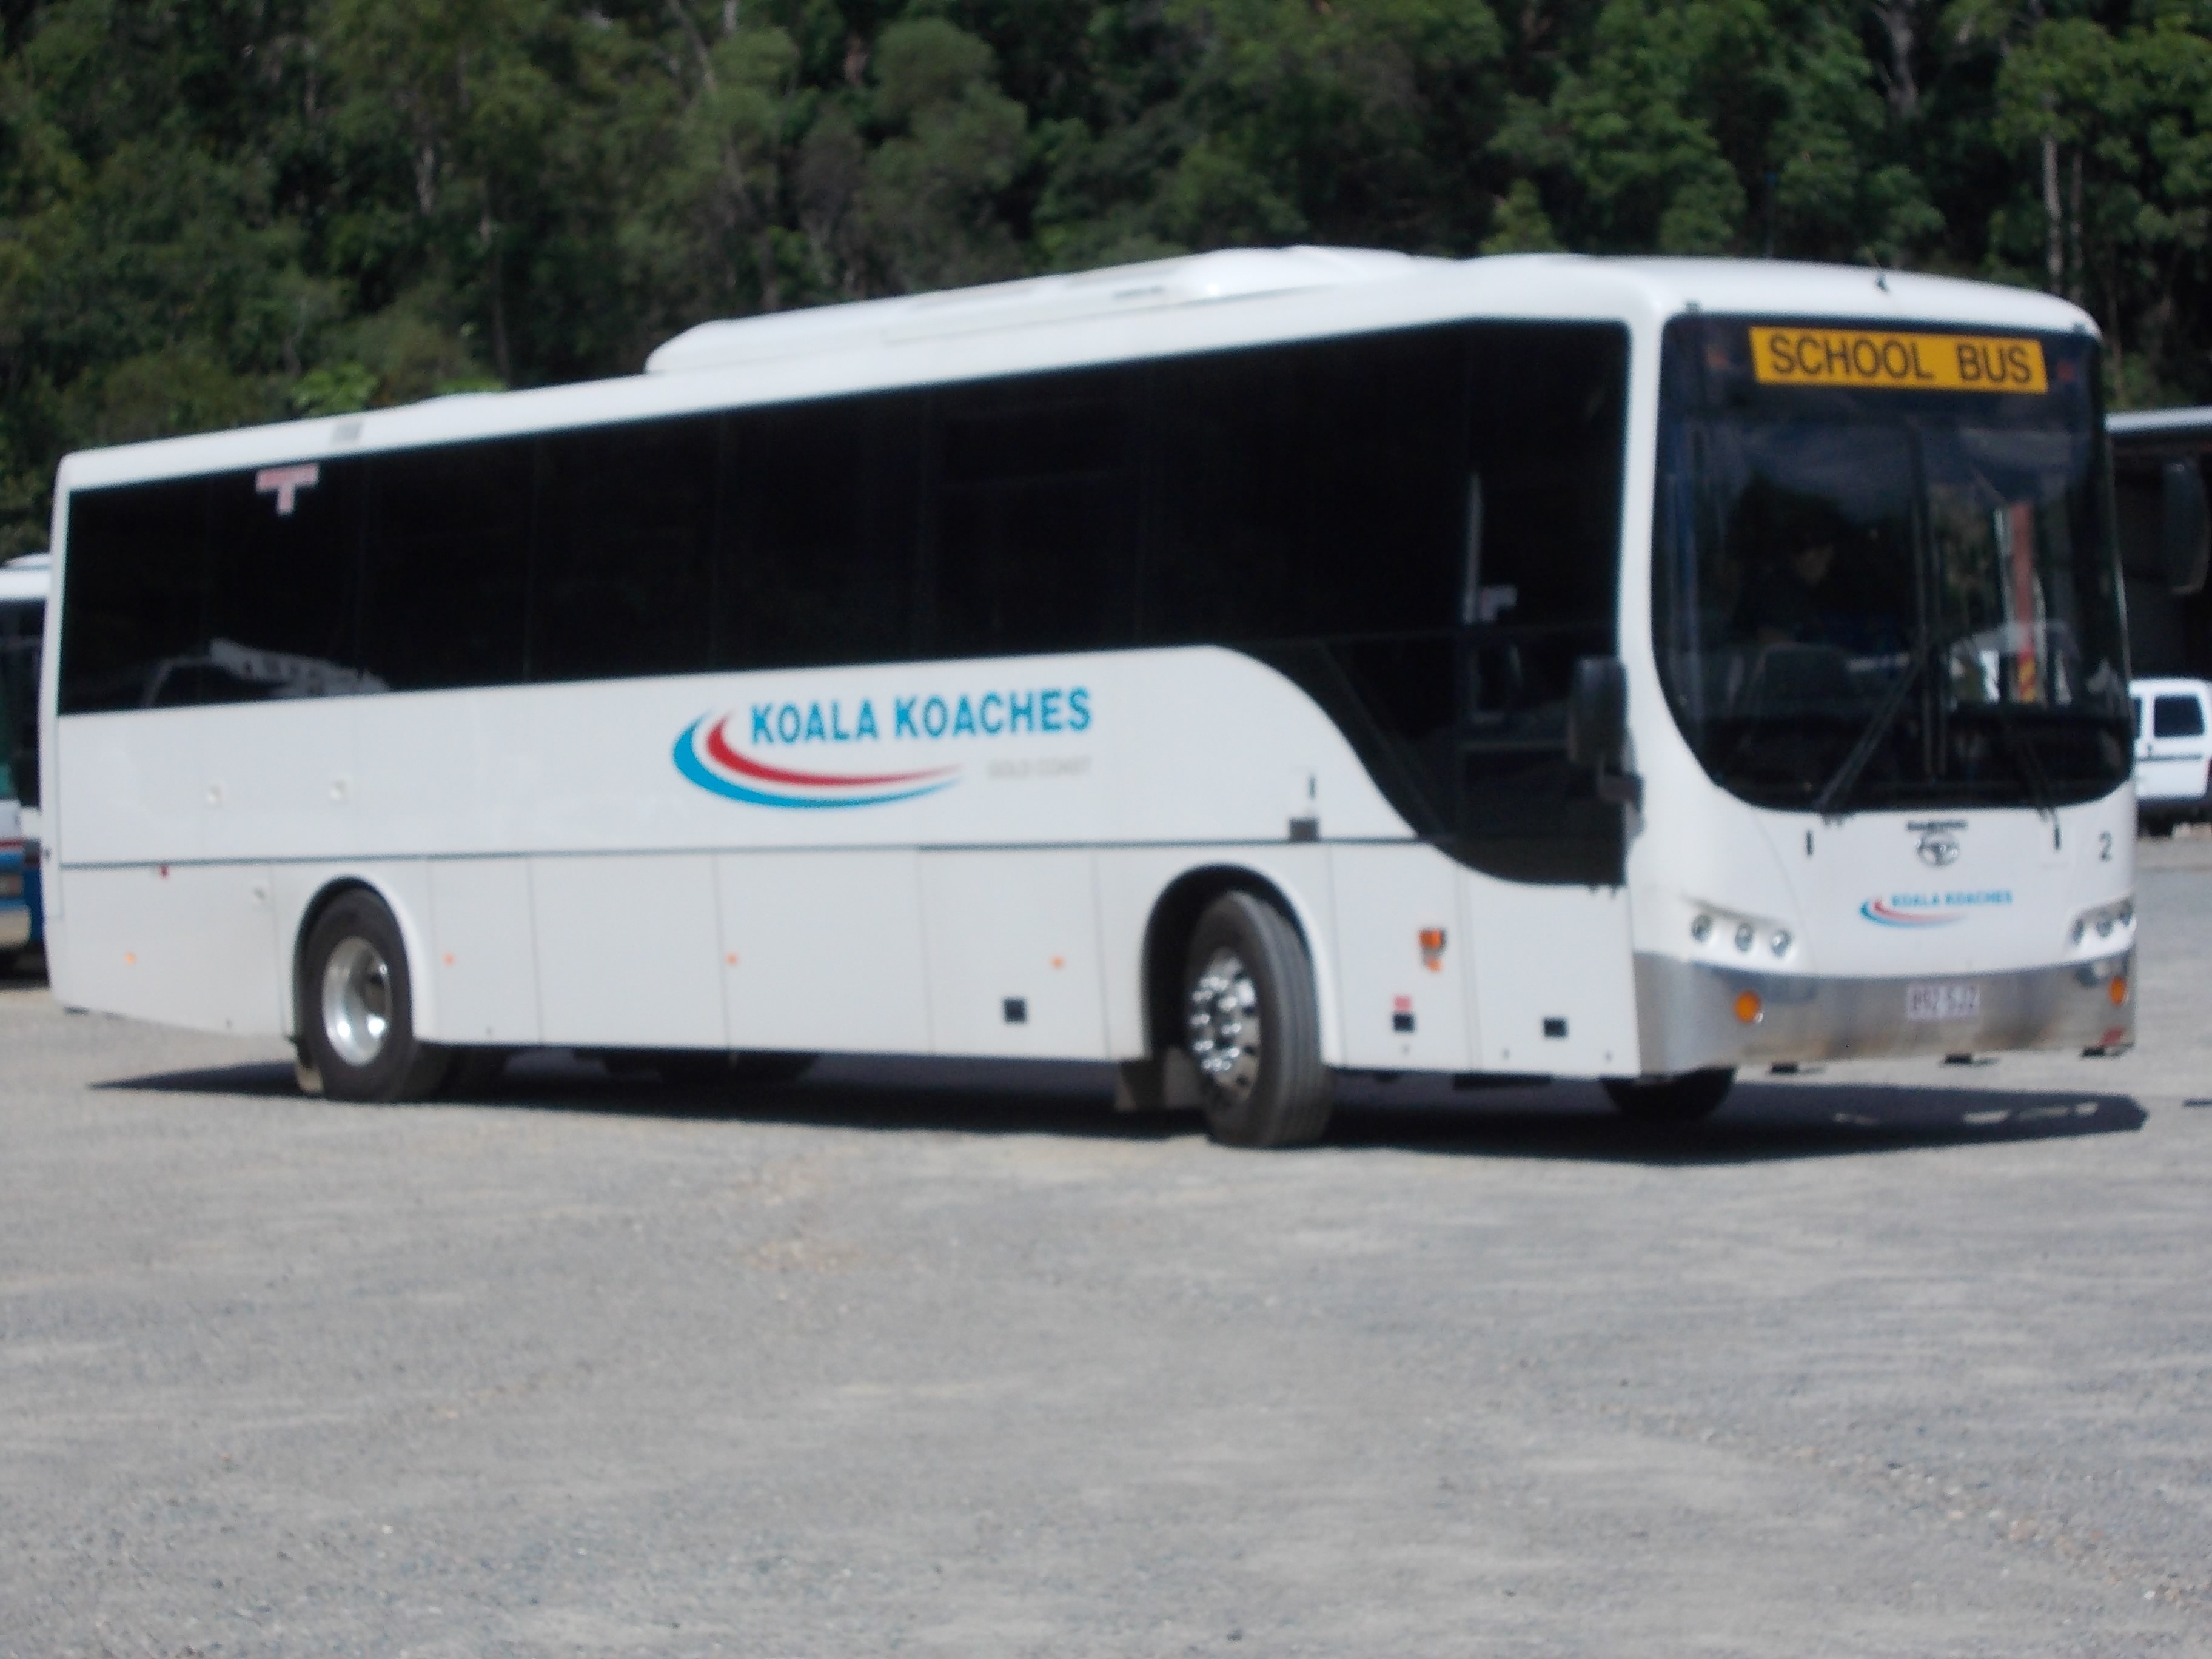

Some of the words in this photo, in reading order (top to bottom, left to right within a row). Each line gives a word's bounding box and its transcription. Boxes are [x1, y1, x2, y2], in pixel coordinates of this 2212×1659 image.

[1769, 333, 1936, 381] SCHOOL
[1955, 343, 2033, 383] BUS
[751, 697, 879, 744] KOALA
[894, 686, 1091, 738] KOACHES
[2098, 831, 2113, 862] 2
[1891, 892, 1941, 907] KOALA
